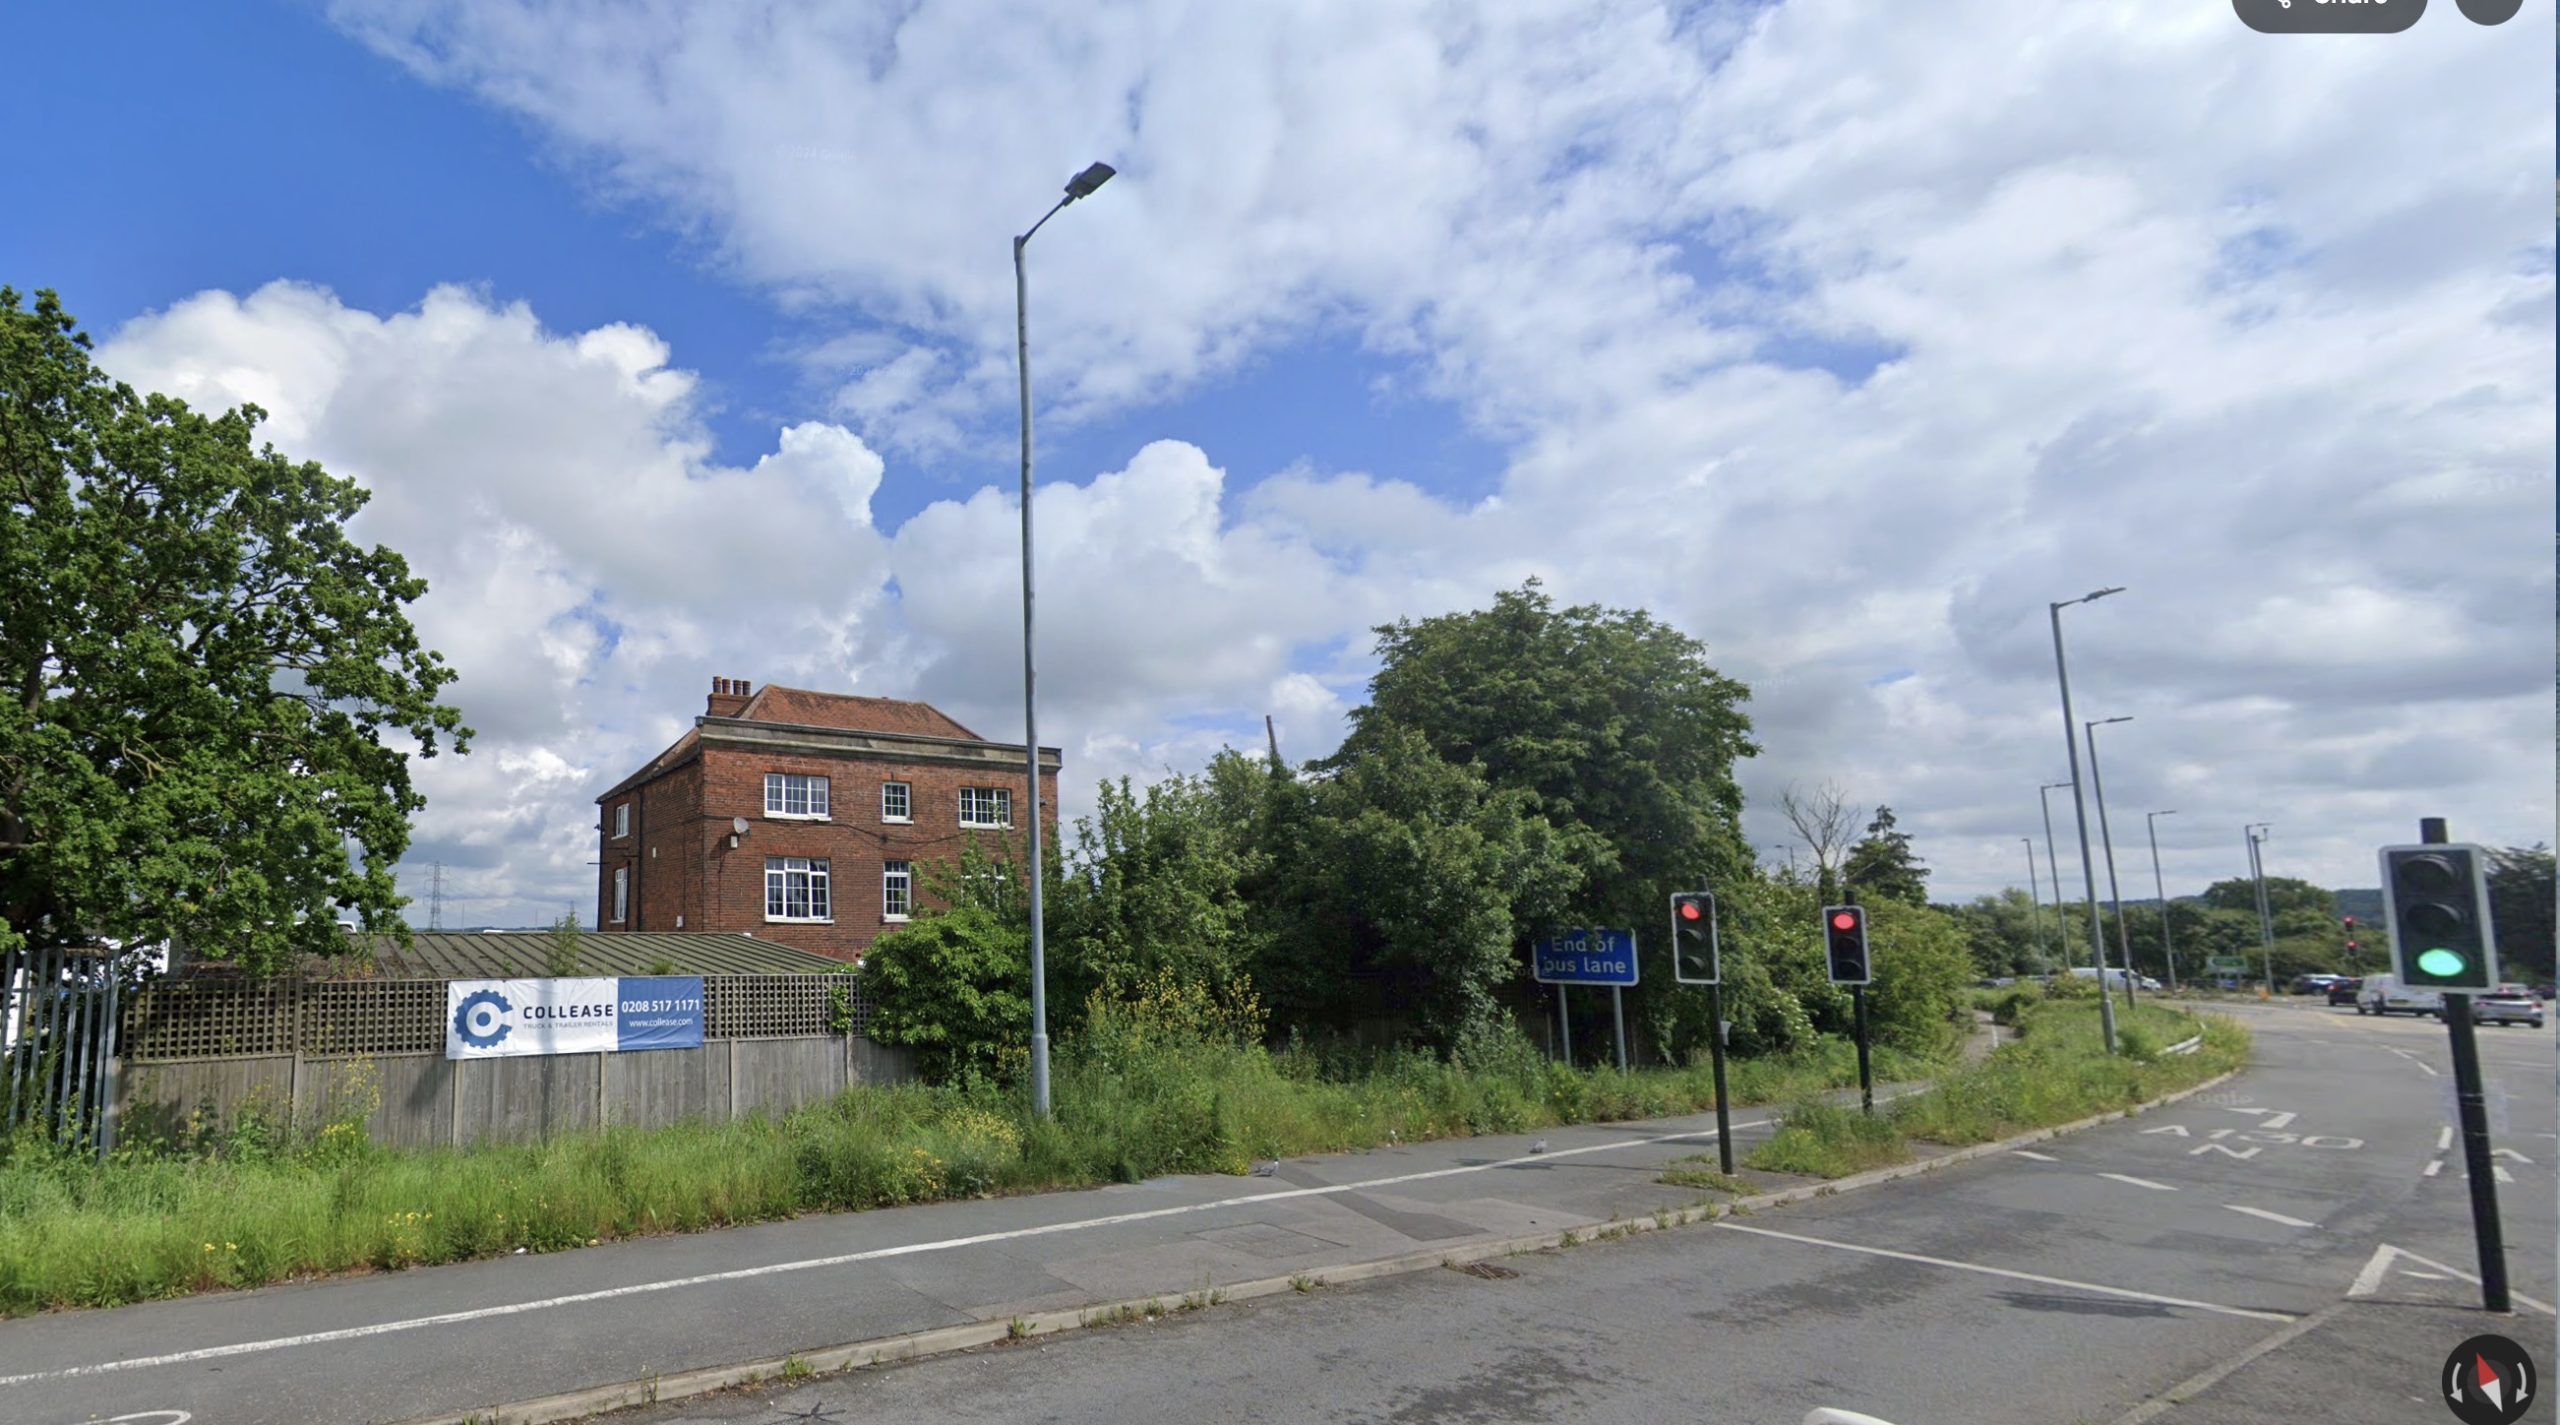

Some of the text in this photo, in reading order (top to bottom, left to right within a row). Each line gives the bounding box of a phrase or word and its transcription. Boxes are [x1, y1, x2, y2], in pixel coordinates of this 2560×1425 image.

[1552, 937, 1615, 952] End of
[1544, 956, 1626, 974] bus lane
[523, 1004, 614, 1020] COLLEASE
[621, 999, 700, 1013] 0208 517 1171
[629, 1017, 694, 1027] www.collease.com
[2139, 1125, 2364, 1149] A130
[2189, 1143, 2263, 1159] N
